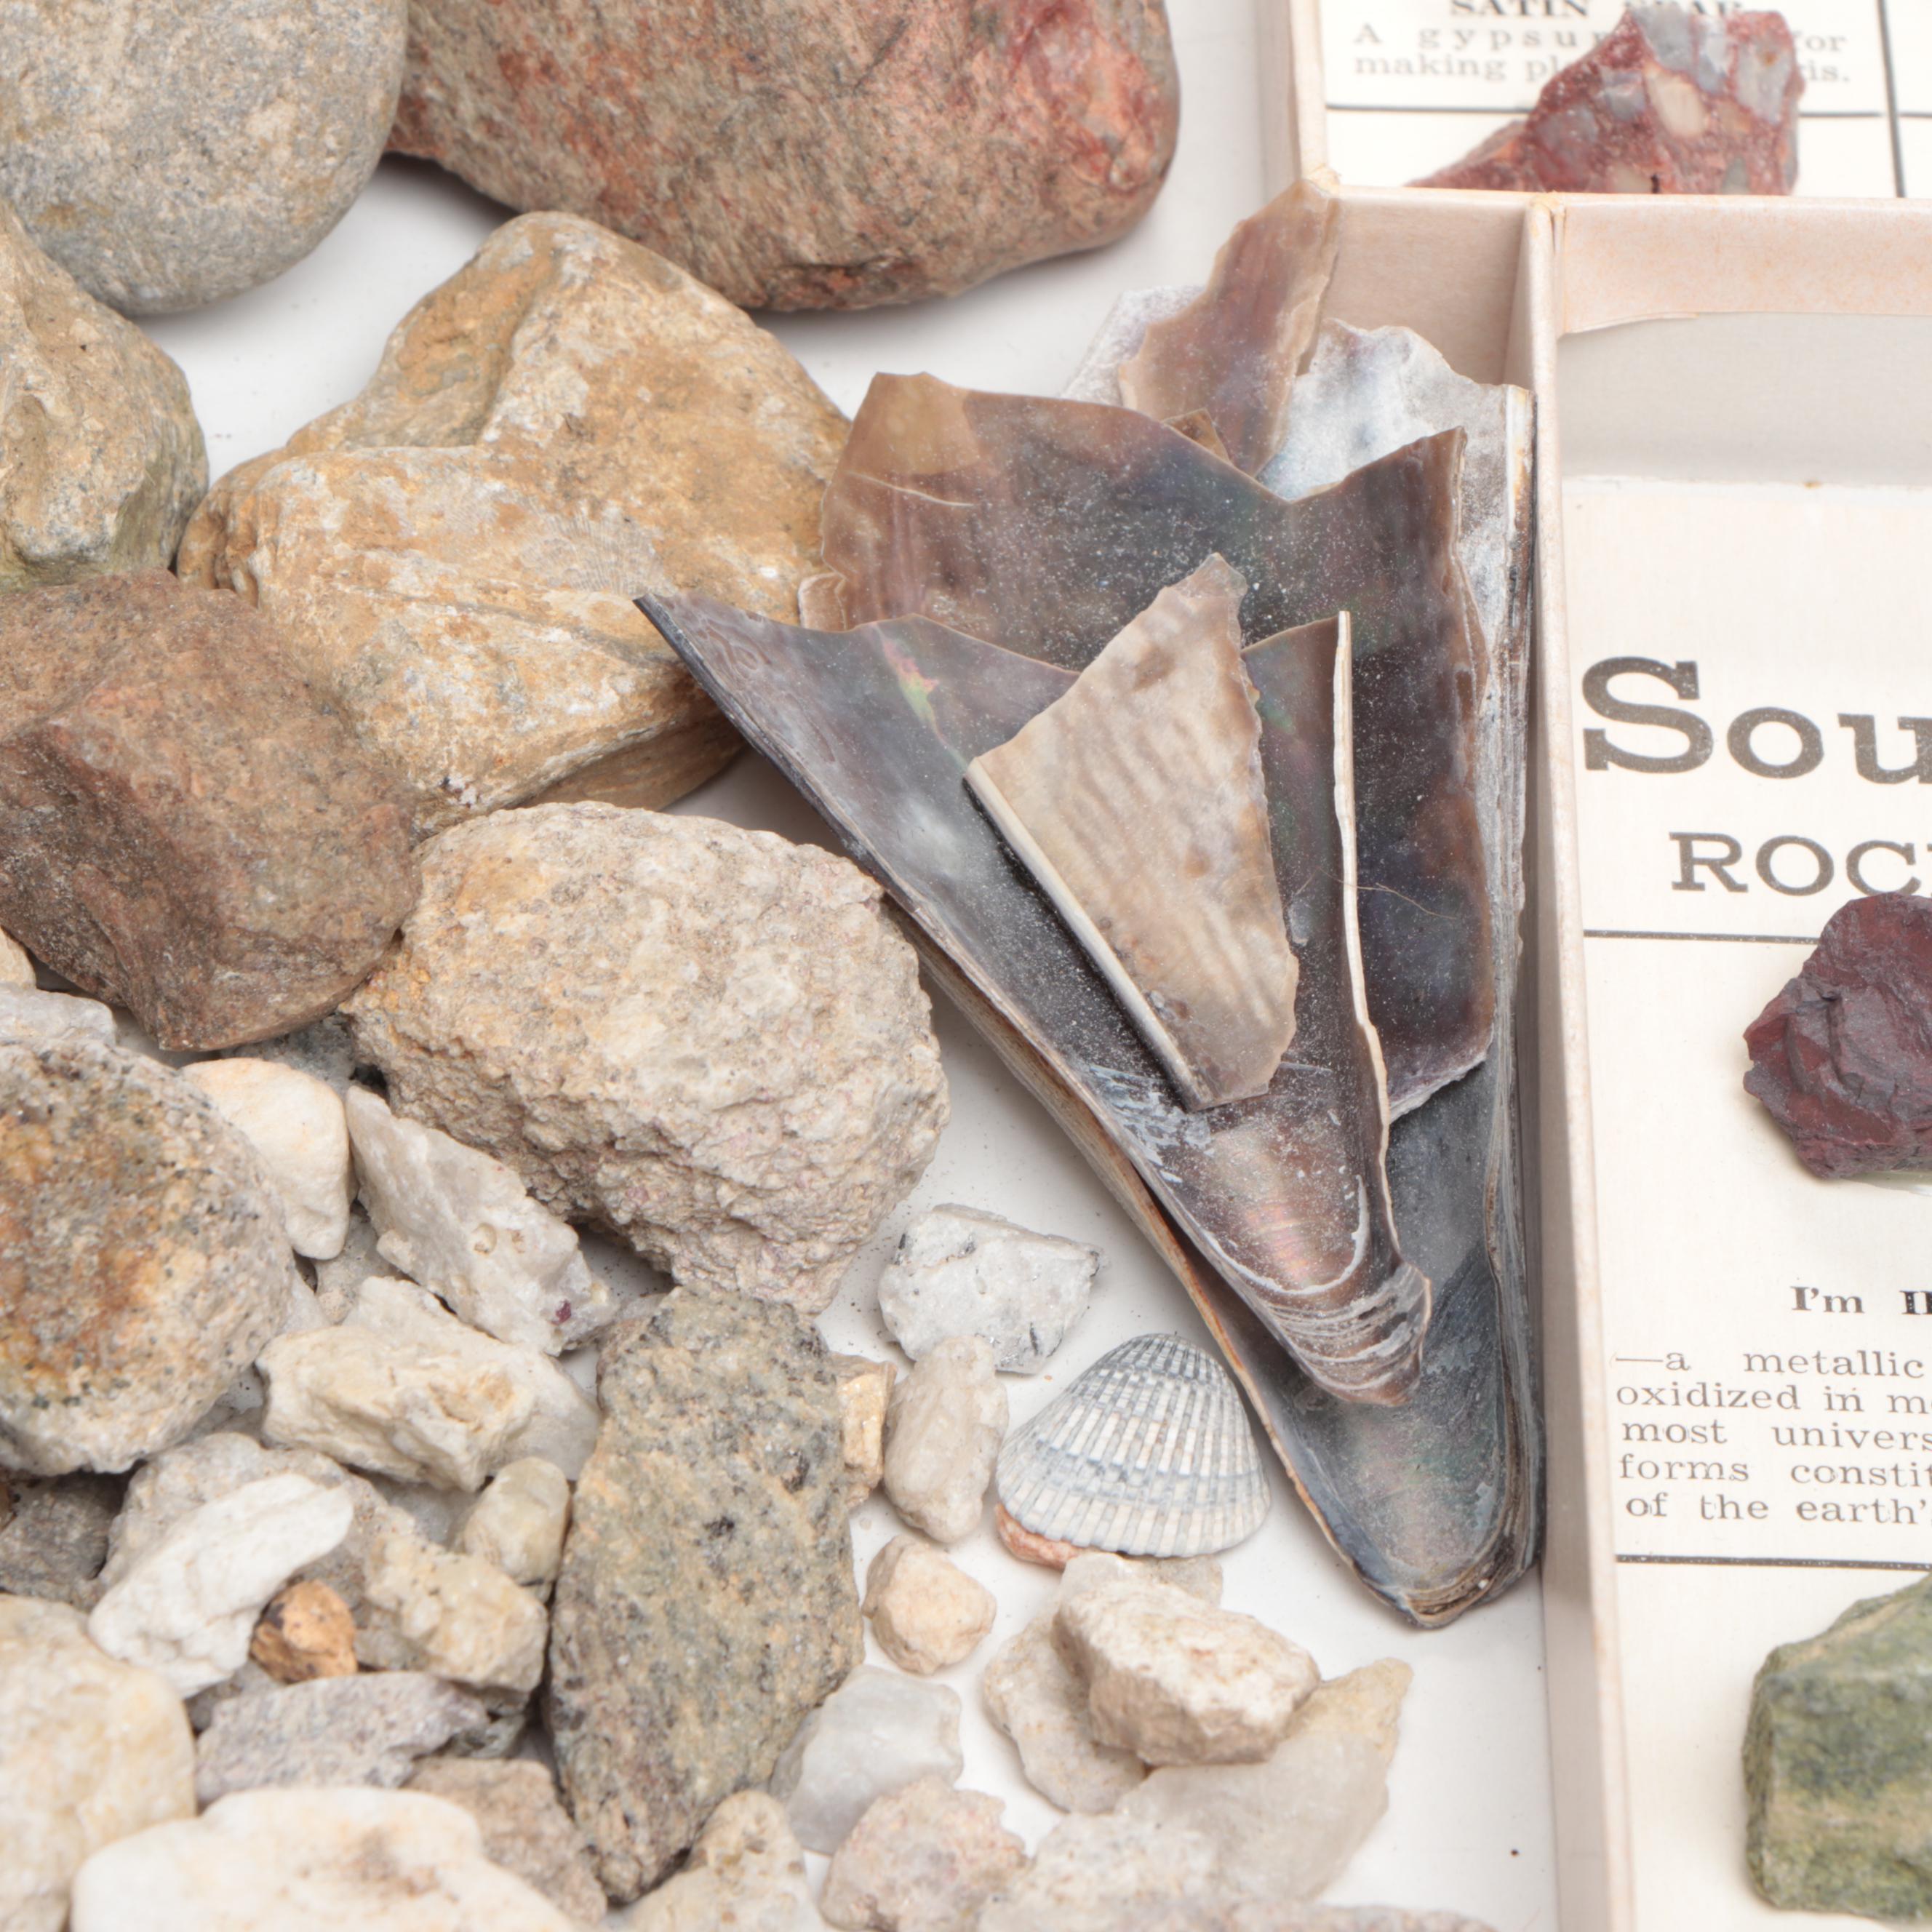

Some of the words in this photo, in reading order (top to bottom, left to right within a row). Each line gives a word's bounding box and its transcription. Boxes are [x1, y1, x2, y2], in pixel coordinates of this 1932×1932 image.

[1354, 23, 1382, 44] A
[1355, 53, 1509, 82] making
[1582, 656, 1932, 785] Sou
[1669, 831, 1932, 897] ROC
[1791, 1286, 1865, 1314] I'm
[1744, 1350, 1925, 1379] metallic
[1616, 1381, 1802, 1410] oxidized
[1824, 1386, 1865, 1413] in
[1622, 1419, 1728, 1445] most
[1620, 1453, 1750, 1482] forms
[1626, 1491, 1669, 1518] of
[1700, 1493, 1770, 1521] the
[1795, 1498, 1932, 1525] earth'
